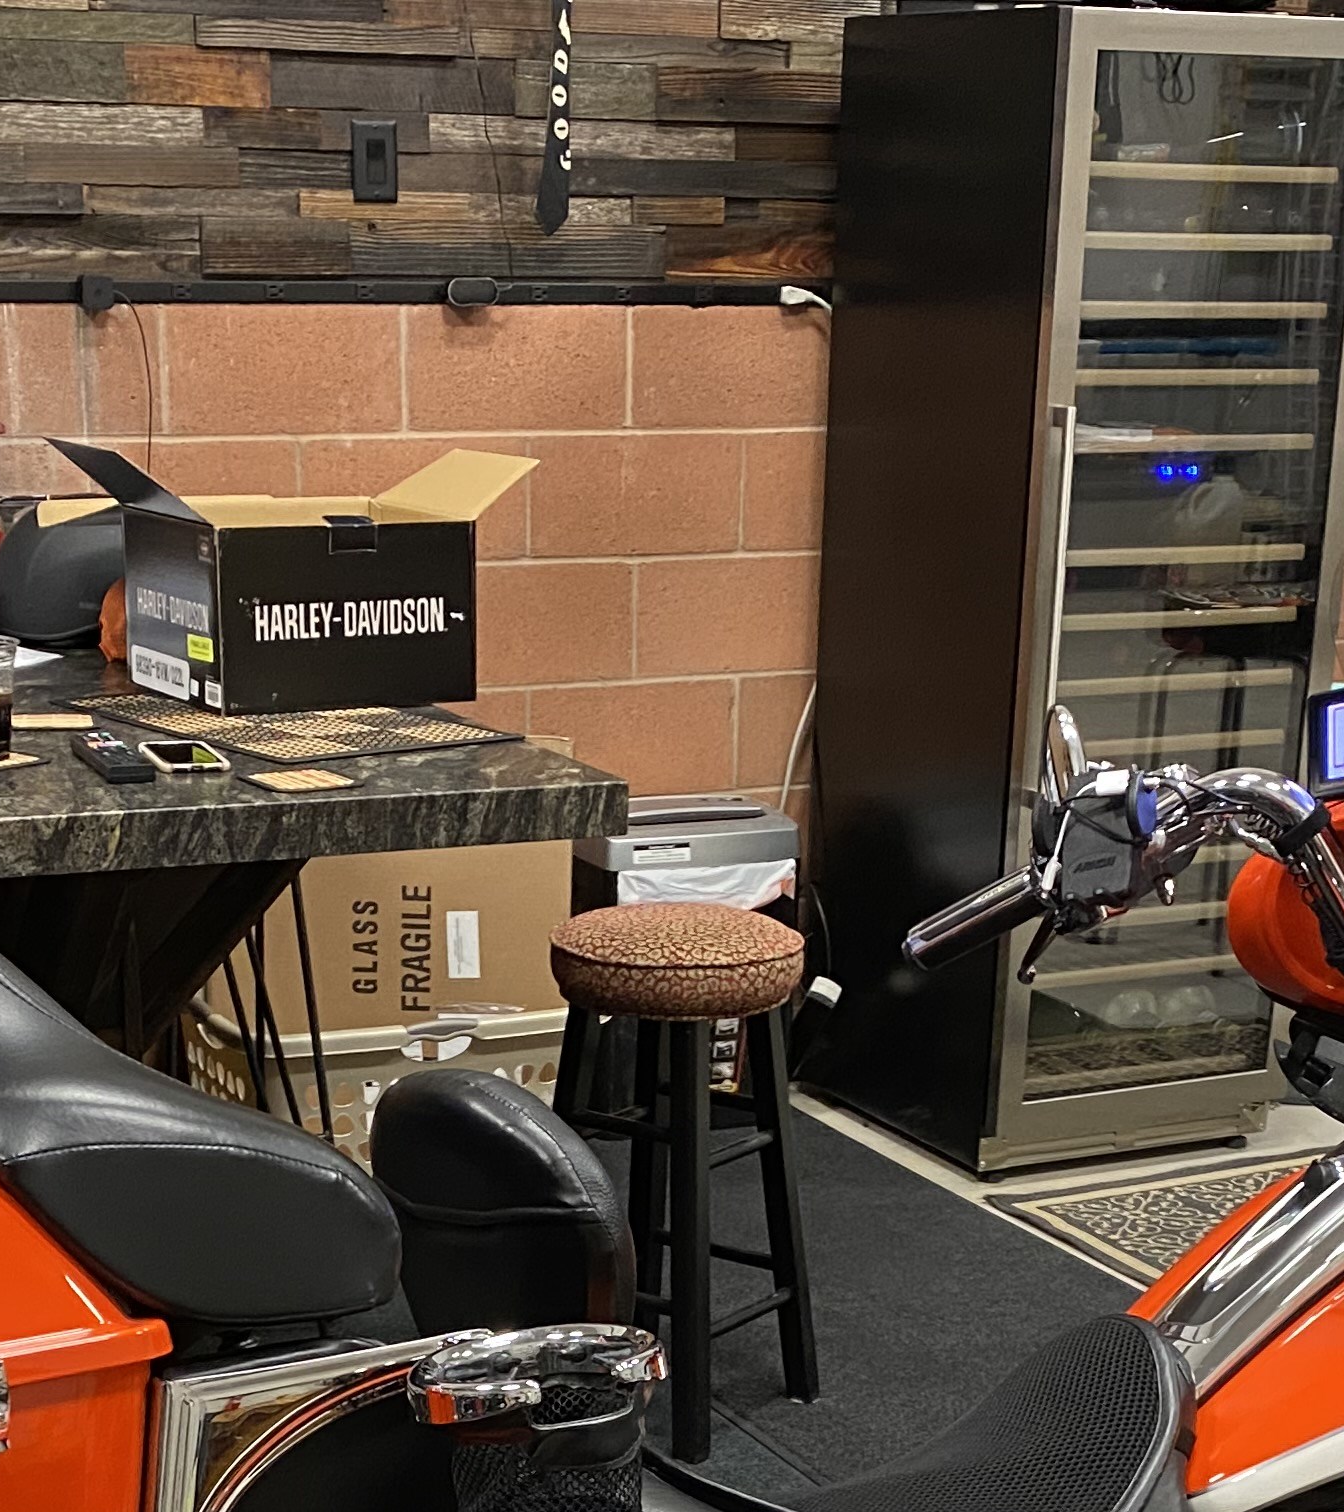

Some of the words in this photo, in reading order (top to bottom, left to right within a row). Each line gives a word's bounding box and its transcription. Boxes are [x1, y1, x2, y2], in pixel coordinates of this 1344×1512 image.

[255, 597, 447, 642] HARLEY-DAVIDSON
[352, 900, 378, 994] GLASS
[400, 884, 432, 1012] FRAGILE
